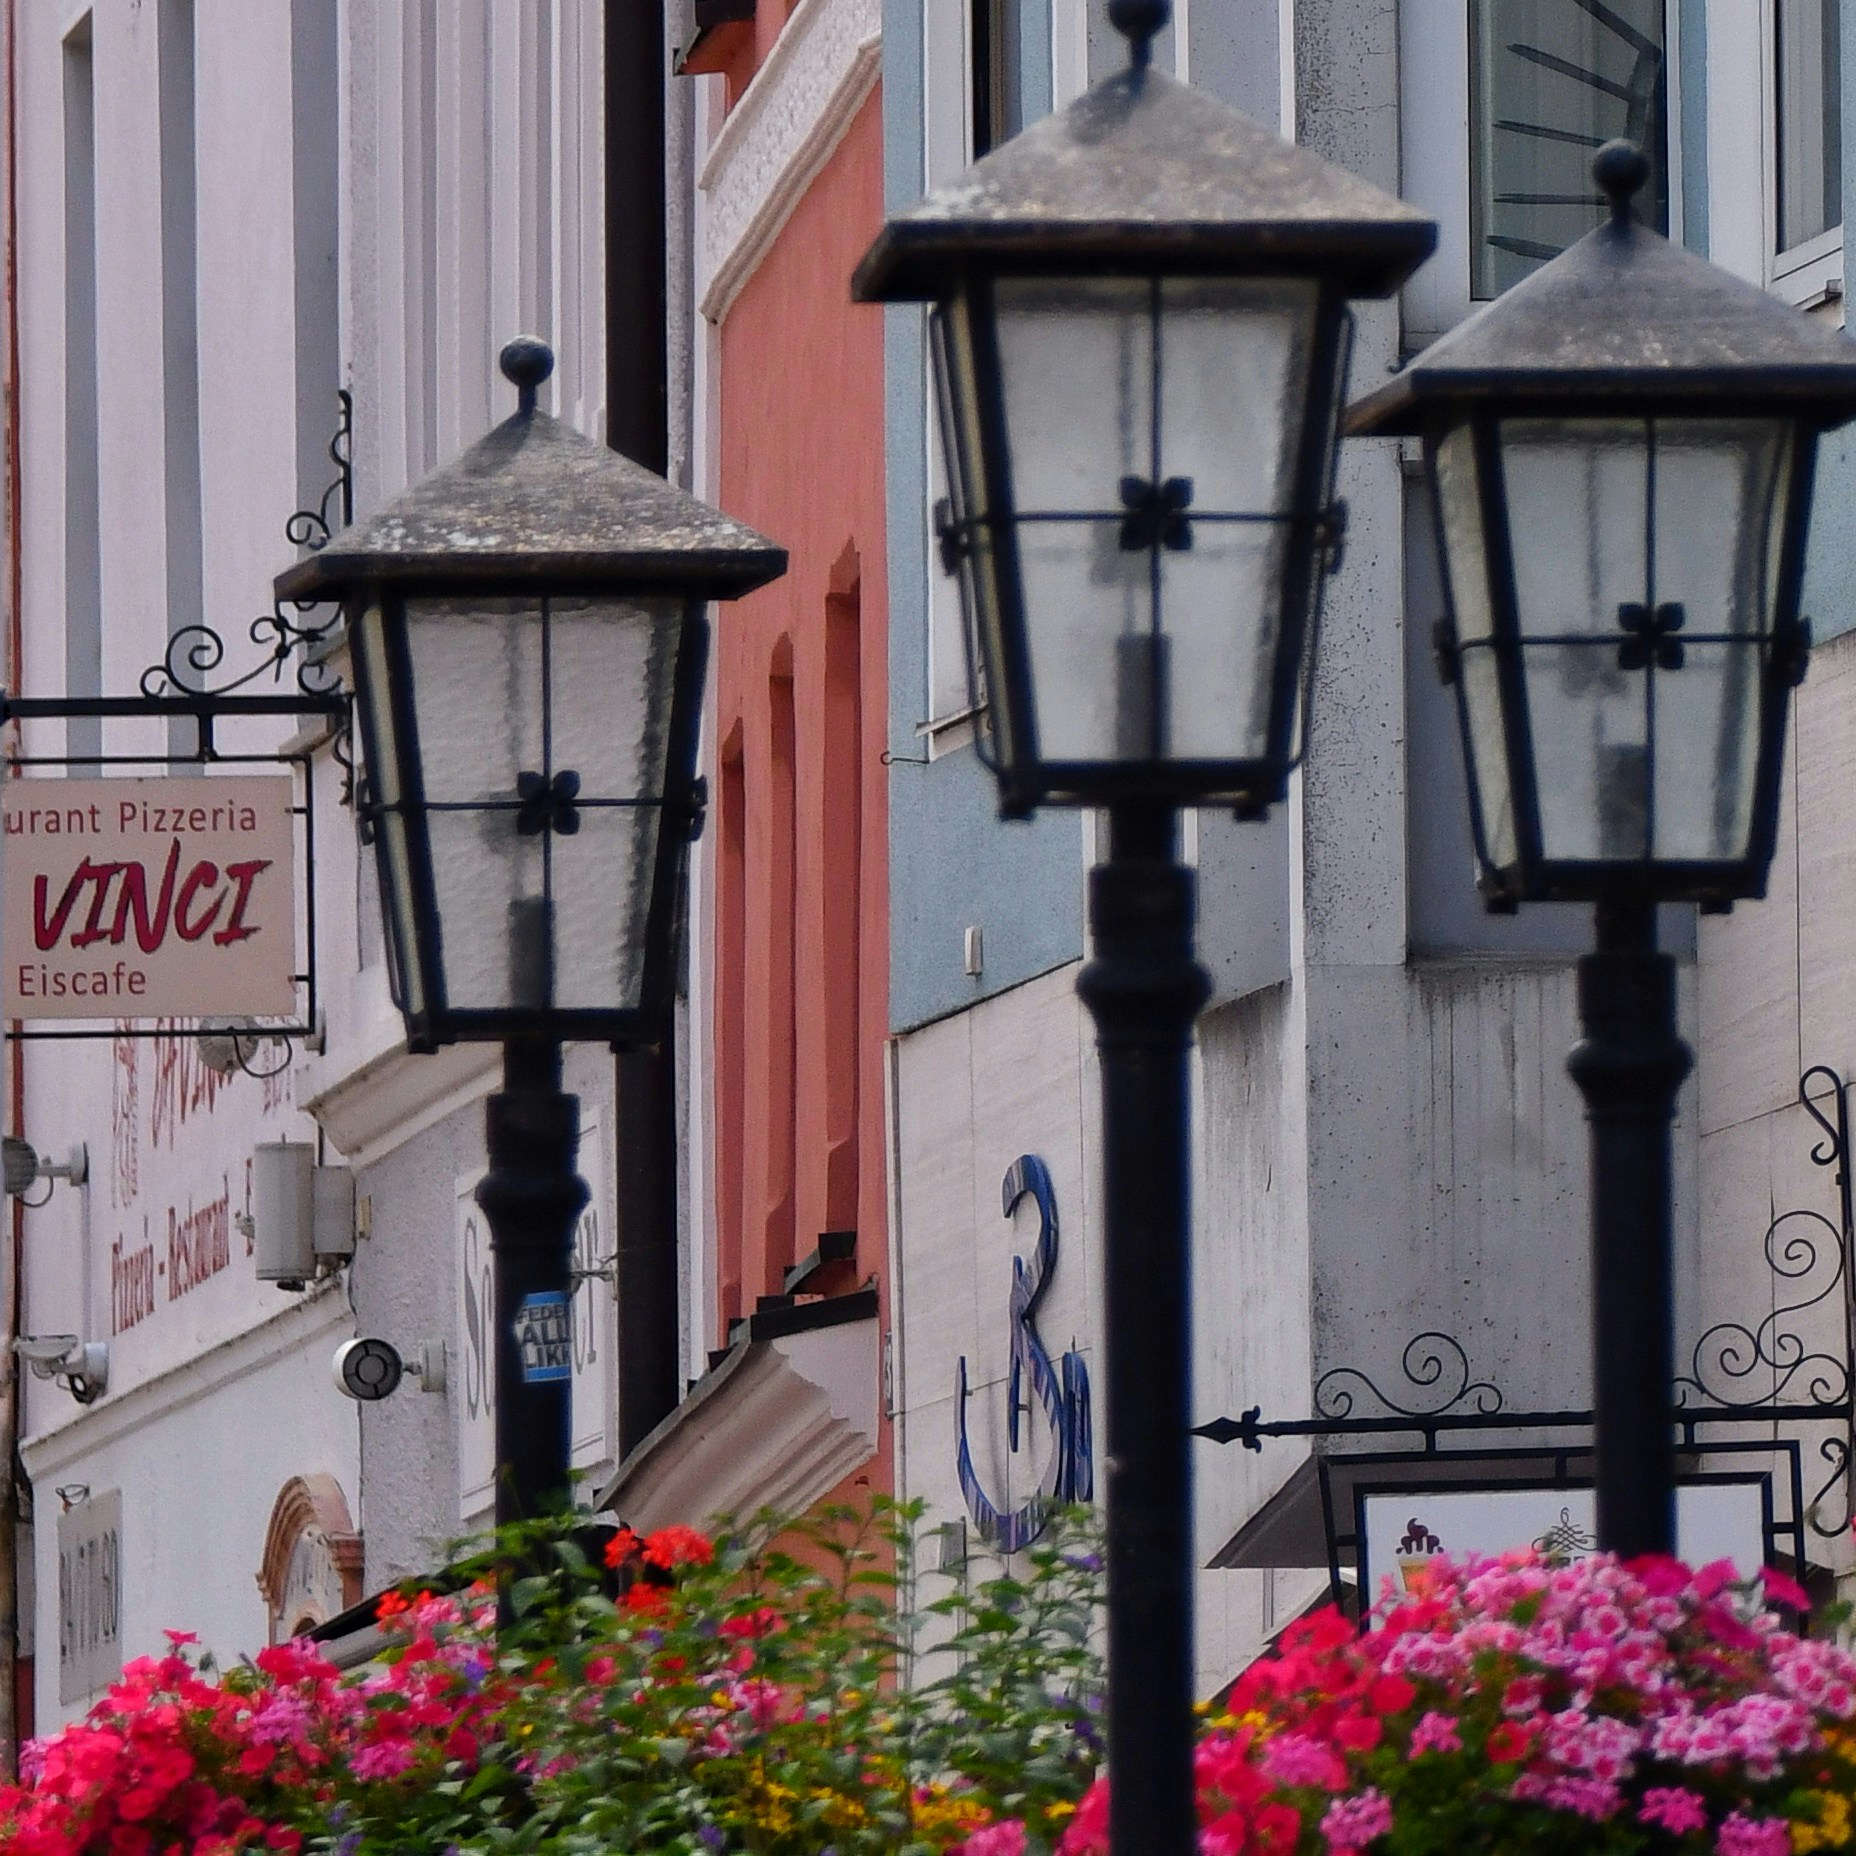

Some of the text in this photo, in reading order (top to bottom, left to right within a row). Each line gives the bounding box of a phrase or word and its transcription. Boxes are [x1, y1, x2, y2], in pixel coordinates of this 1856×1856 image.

[4, 799, 257, 834] urant Pizzeria
[34, 837, 274, 955] VINCI
[18, 961, 147, 996] Eiscafe
